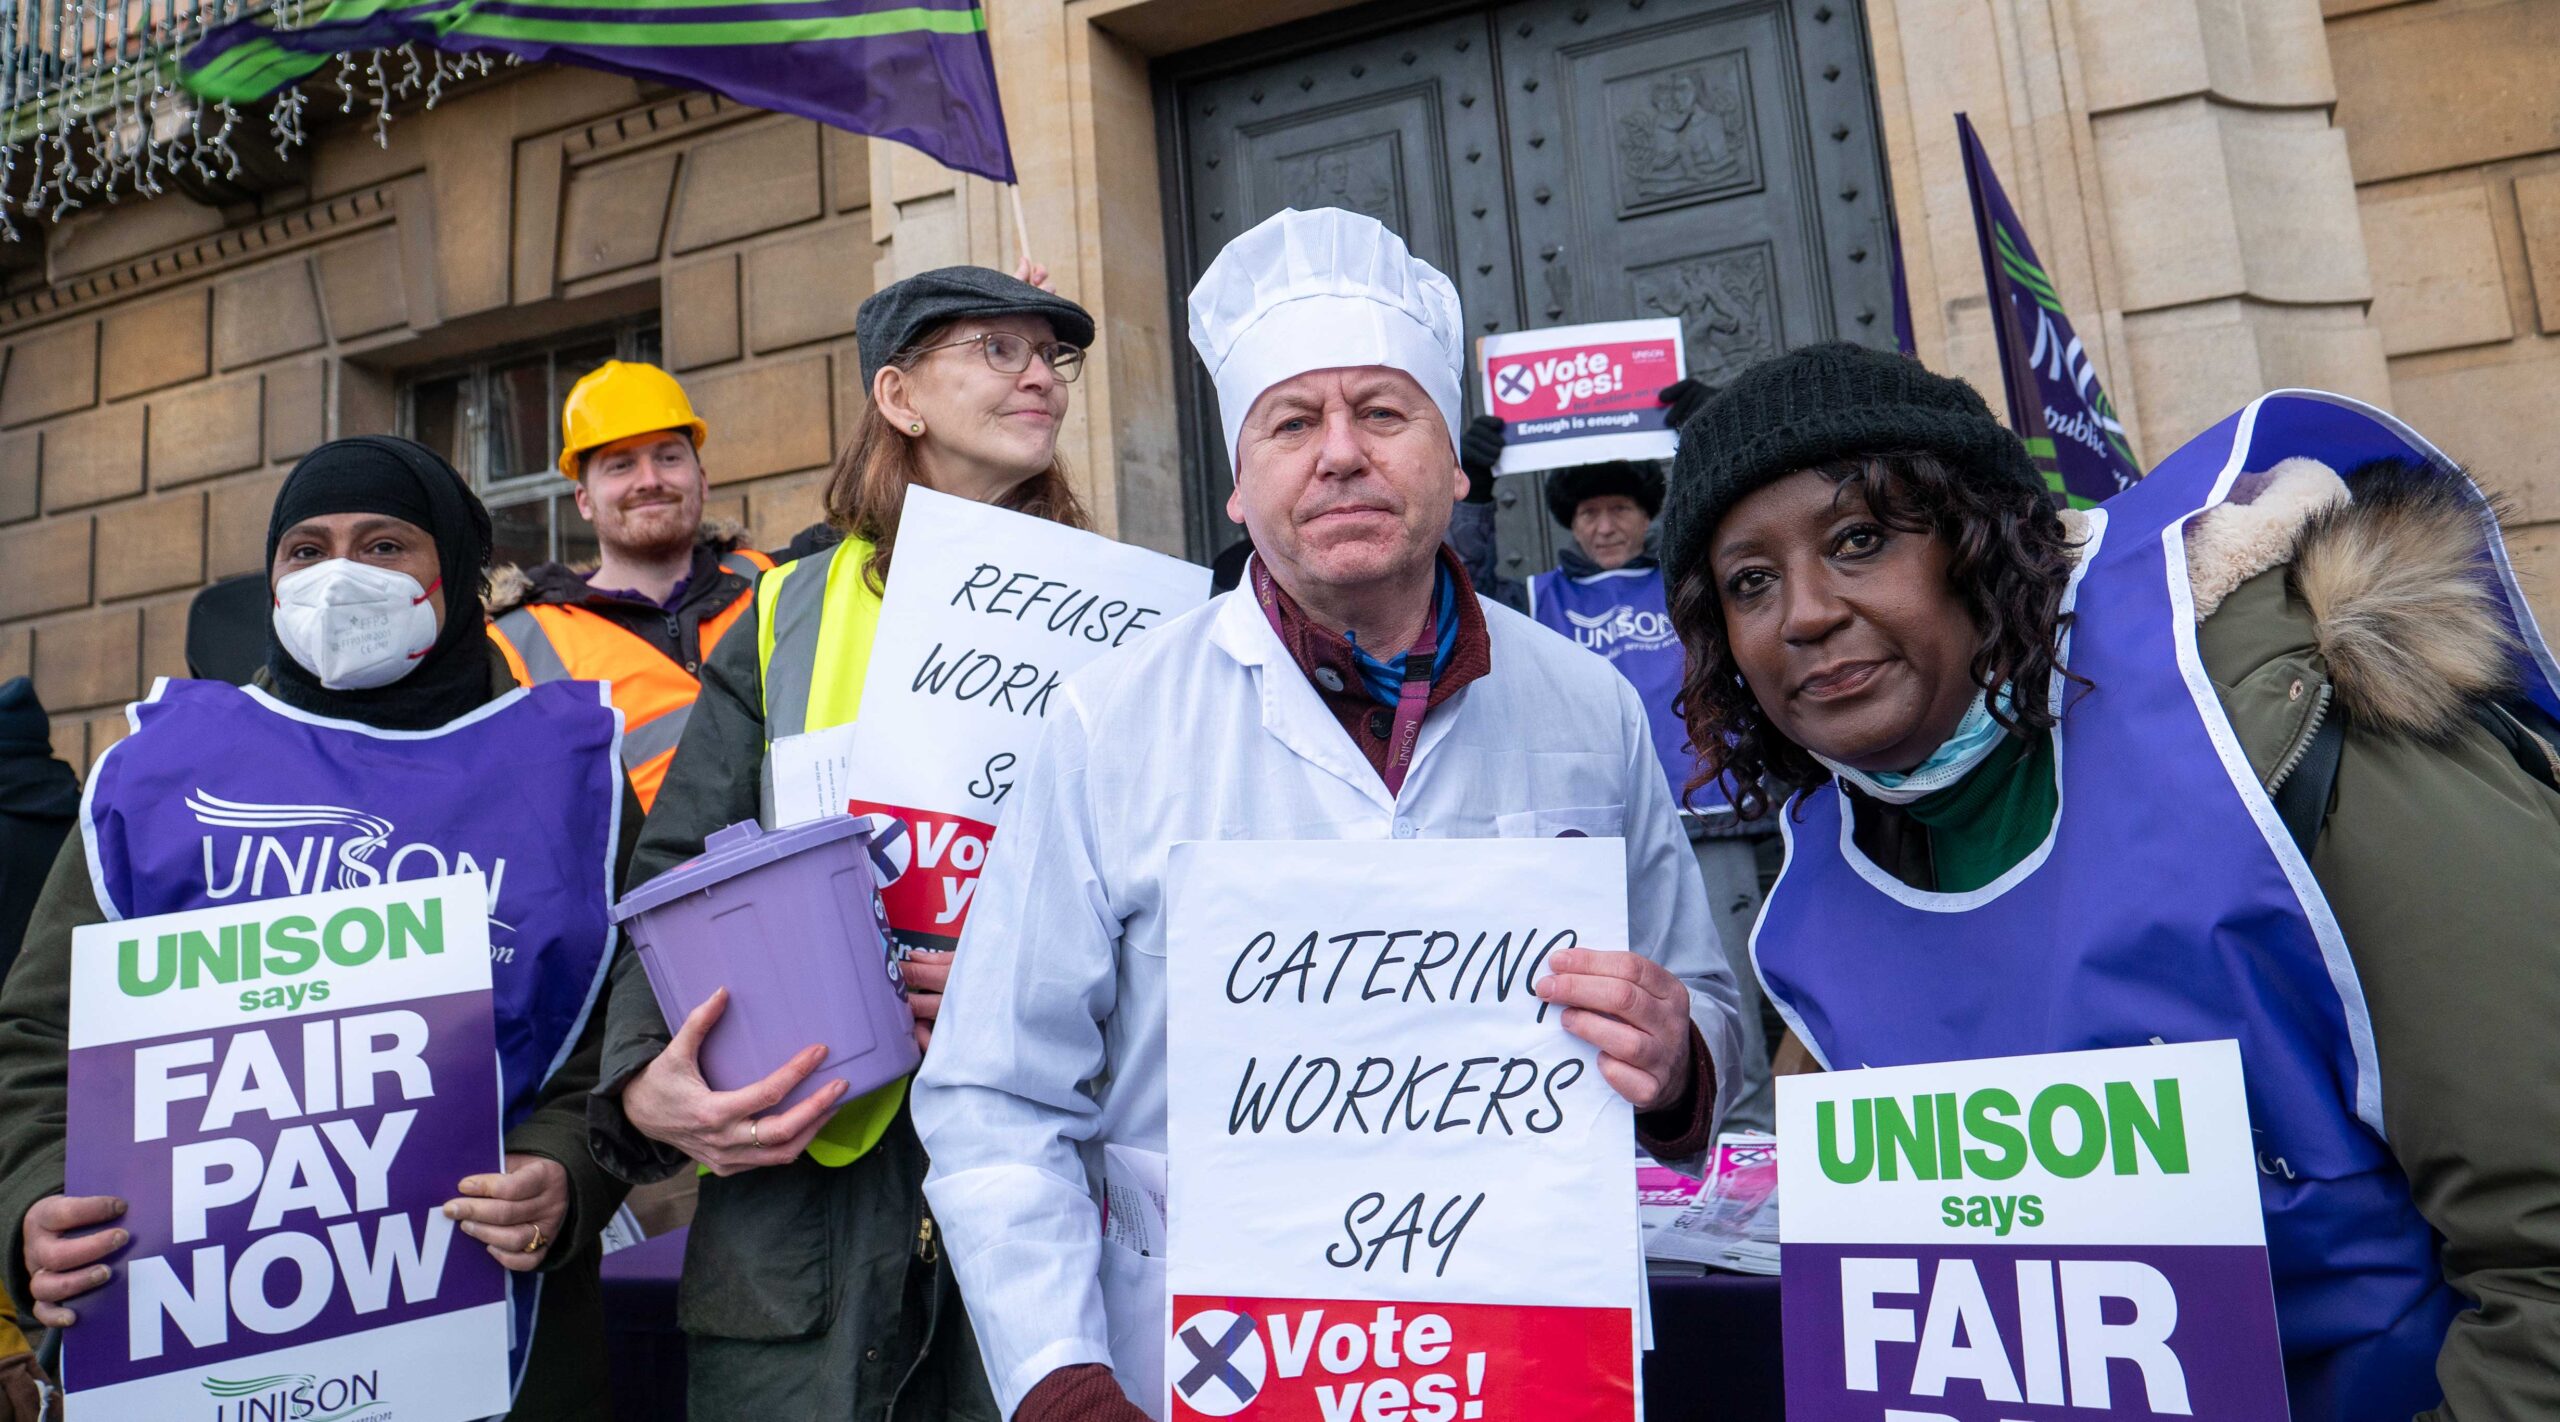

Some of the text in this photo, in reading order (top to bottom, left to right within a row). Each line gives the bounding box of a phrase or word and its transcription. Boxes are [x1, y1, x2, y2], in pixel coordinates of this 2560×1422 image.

[1534, 352, 1609, 387] Vote
[1555, 365, 1623, 410] yes!
[1517, 411, 1640, 436] Enough is enough
[950, 563, 1161, 648] REFUSE
[911, 642, 1063, 718] WORK
[1399, 720, 1417, 767] UNISON
[916, 821, 993, 871] Vo
[117, 897, 445, 997] UNISON
[238, 978, 330, 1012] says
[133, 1009, 436, 1143] FAIR
[1227, 1054, 1585, 1135] WORKERS
[1816, 1078, 2190, 1184] UNISON
[171, 1109, 418, 1244] PAY
[1941, 1191, 2045, 1237] says
[1325, 1191, 1486, 1277] SAY
[128, 1206, 455, 1362] NOW
[1266, 1306, 1453, 1379] Vote
[1839, 1256, 2194, 1416] FAIR
[1314, 1351, 1487, 1422] yes!
